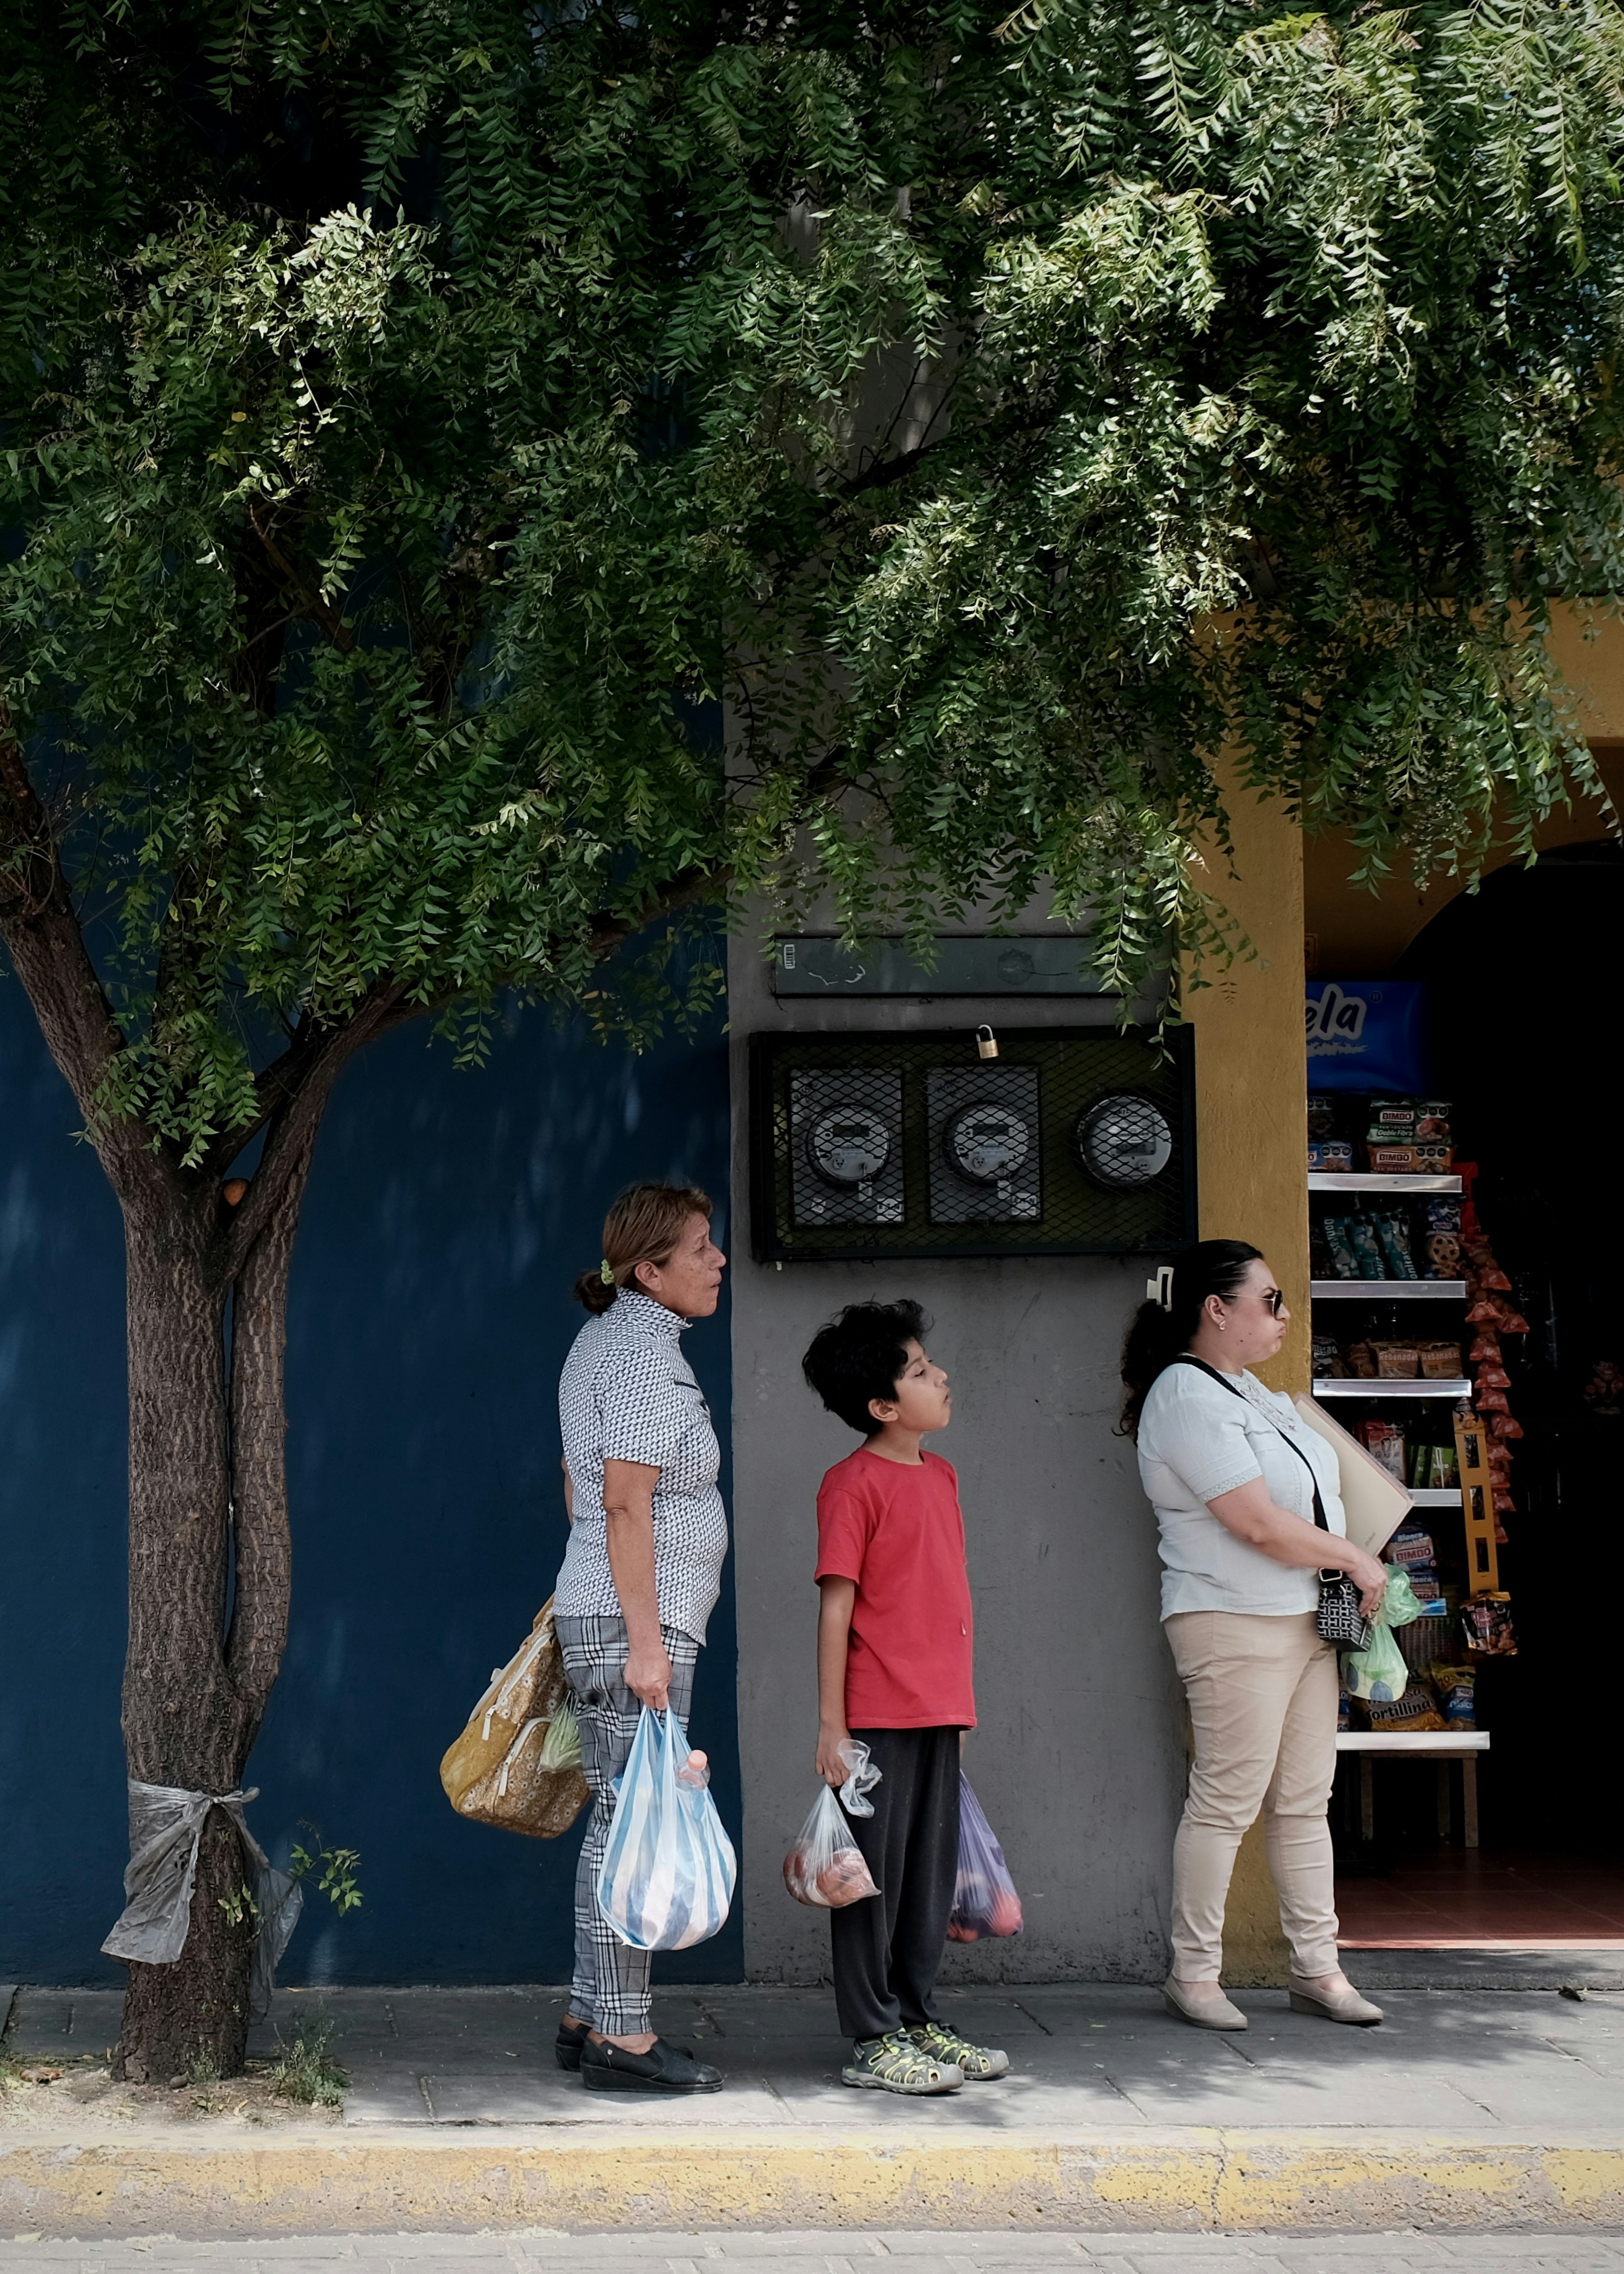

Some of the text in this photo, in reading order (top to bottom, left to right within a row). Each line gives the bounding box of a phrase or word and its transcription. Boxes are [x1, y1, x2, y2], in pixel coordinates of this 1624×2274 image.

[1379, 1352, 1418, 1361] Rebanadas
[1422, 1351, 1460, 1361] Rebanadas
[1397, 1532, 1423, 1542] Blanco
[1396, 1548, 1431, 1561] BIMBO
